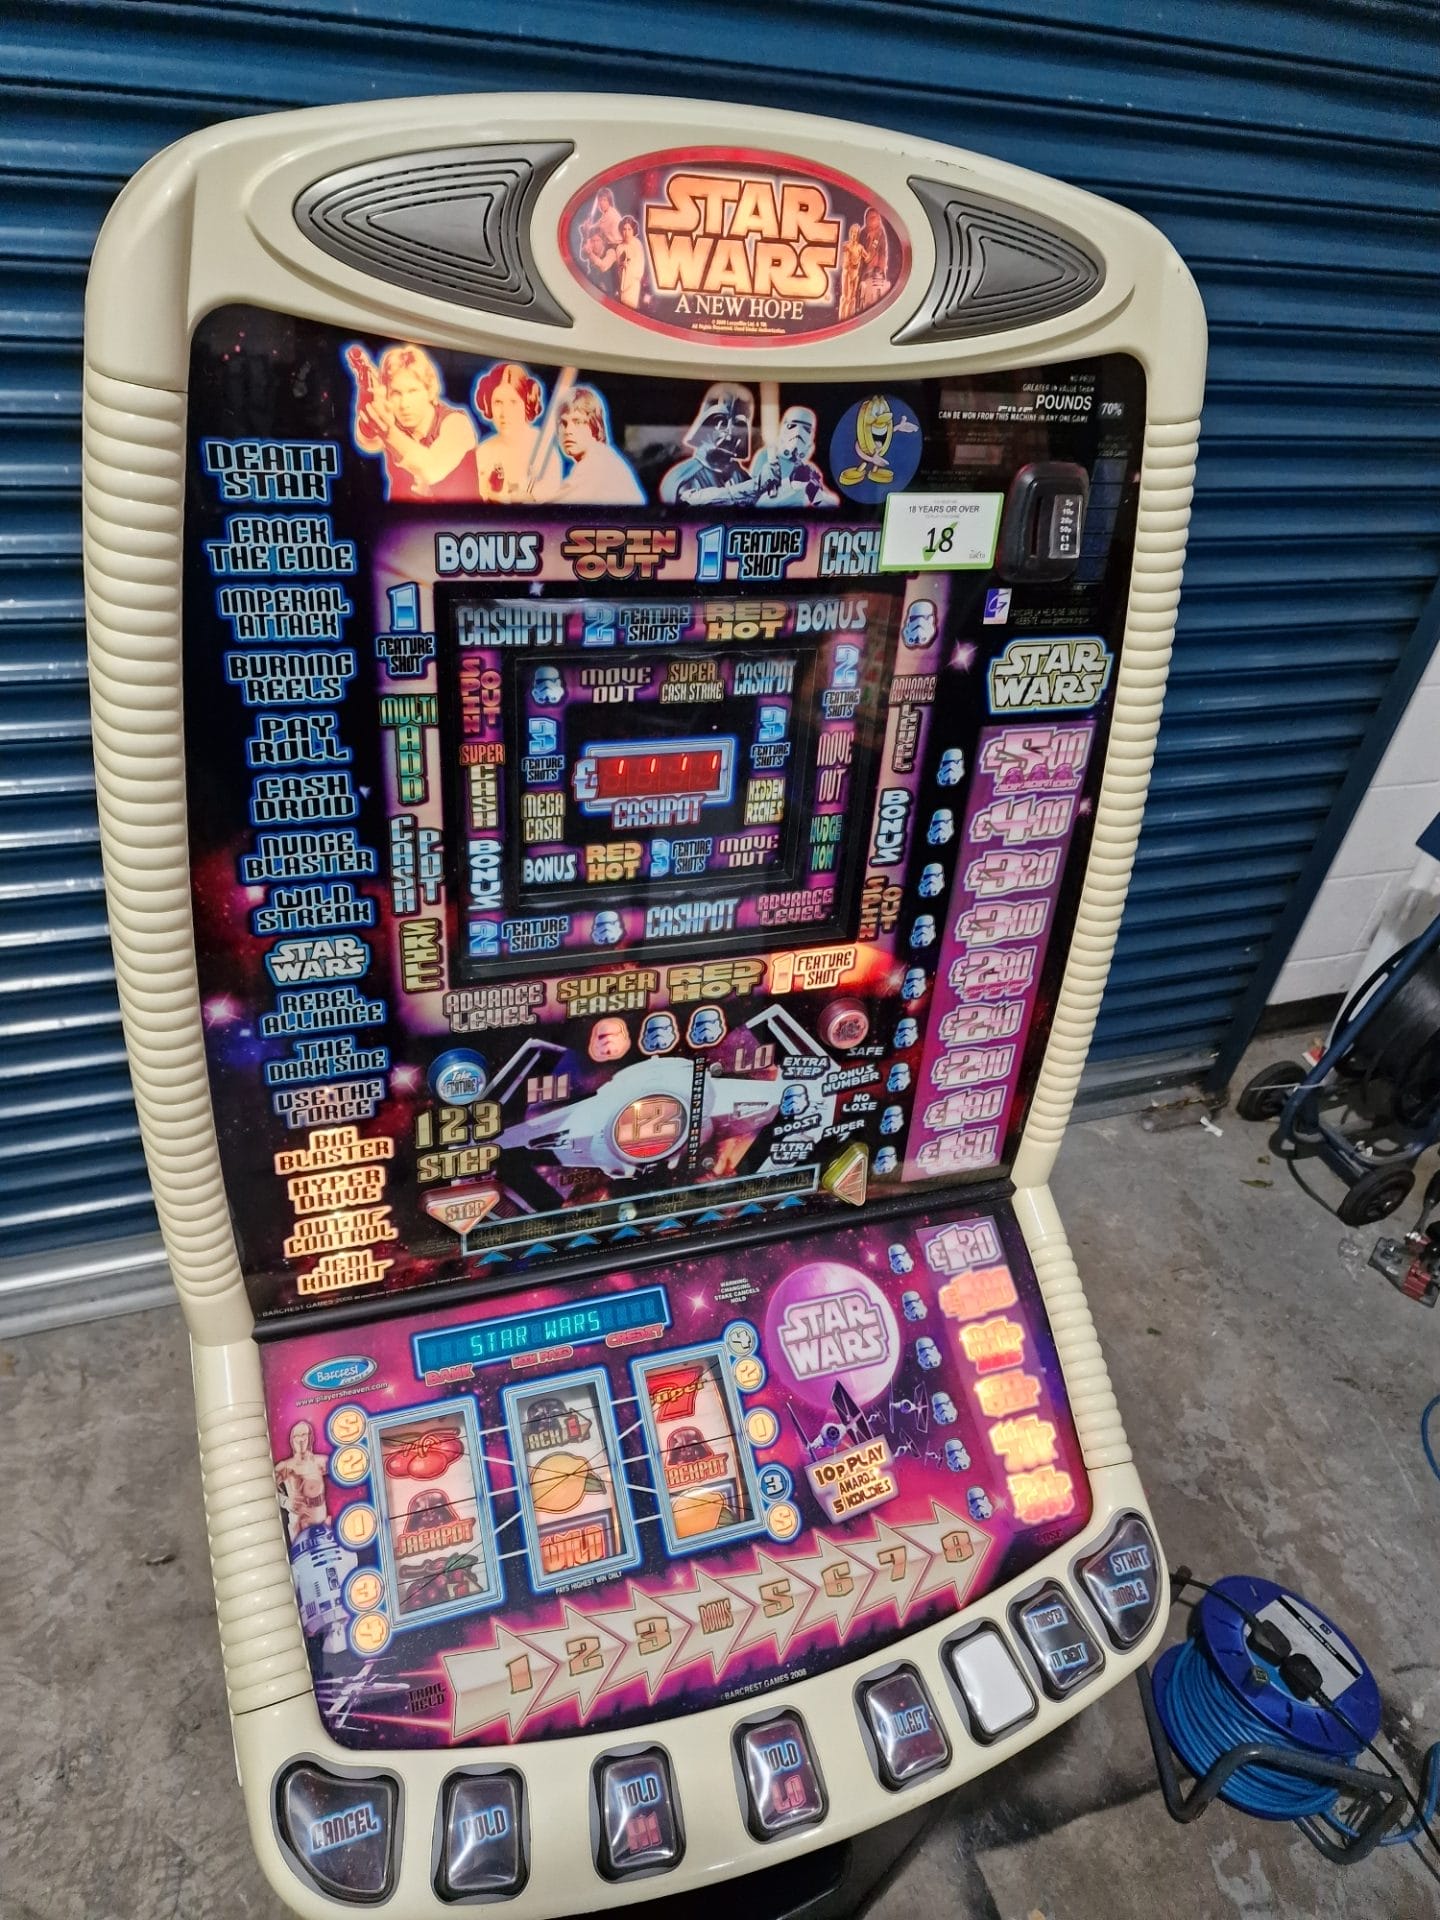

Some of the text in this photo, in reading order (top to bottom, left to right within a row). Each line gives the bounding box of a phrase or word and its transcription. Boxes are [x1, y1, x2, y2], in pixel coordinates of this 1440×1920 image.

[646, 174, 840, 242] STAR
[648, 233, 838, 299] WARS
[674, 294, 804, 320] A NEW HOPE
[939, 411, 951, 419] CAN
[953, 411, 960, 419] BE
[977, 412, 994, 420] FROM
[996, 412, 1008, 420] THIS
[1036, 395, 1092, 410] POUNDS
[1101, 402, 1122, 416] 70%
[206, 442, 337, 473] DEATH
[224, 471, 328, 500] STAR
[231, 518, 329, 545] CRACK
[564, 529, 676, 554] SPIN
[730, 529, 801, 554] FEATURE
[925, 528, 954, 552] 18
[207, 545, 353, 572] THE CODE
[436, 533, 539, 574] BONUS
[699, 526, 724, 580] 1
[743, 554, 785, 577] SHOT
[575, 554, 659, 579] OUT
[220, 587, 350, 615] IMPERIAL
[388, 583, 417, 631] 1
[703, 602, 786, 622] RED
[238, 613, 338, 639] ATTACK
[458, 607, 566, 646] CASHPOT
[585, 604, 614, 645] 2
[620, 606, 689, 625] FEATURE
[796, 601, 868, 632] BONUS
[629, 624, 678, 641] SHOTS
[707, 621, 784, 641] HOT
[377, 636, 434, 657] FEATURE
[995, 643, 1106, 676] STAR
[228, 653, 352, 681] BURNING
[390, 654, 424, 674] SHOT
[581, 667, 650, 685] MOVE
[669, 662, 716, 680] SUPER
[834, 644, 858, 686] 2
[247, 678, 343, 703] REELS
[734, 661, 797, 695] CASHPOT
[890, 675, 937, 702] ADVANCE
[994, 673, 1103, 708] WARS
[592, 685, 641, 703] OUT
[661, 684, 689, 703] CASH
[380, 695, 438, 726] MULTI
[759, 705, 787, 742] 3
[260, 715, 335, 741] PAY
[529, 718, 556, 755] 3
[250, 738, 349, 764] ROLL
[461, 744, 505, 765] SUPER
[523, 756, 564, 771] FEATURE
[257, 775, 347, 800] CASH
[819, 768, 847, 801] OUT
[255, 796, 355, 822] DROID
[523, 793, 565, 817] MEGA
[612, 797, 703, 829] CASHPOT
[525, 818, 563, 841] CASH
[261, 832, 354, 857] NUDGE
[586, 841, 643, 862] RED
[672, 839, 711, 858] FEATURE
[720, 835, 778, 853] MOVE
[245, 850, 374, 880] BLASTER
[524, 855, 577, 883] BONUS
[587, 861, 640, 882] HOT
[729, 850, 769, 868] OUT
[275, 885, 351, 909] WILD
[257, 902, 370, 932] STREAK
[503, 917, 568, 938] FEATURE
[646, 898, 739, 939] CASHPOT
[760, 906, 829, 925] LEVEL
[271, 938, 365, 963] STAR
[470, 921, 498, 956] 2
[511, 935, 559, 951] SHOTS
[271, 956, 365, 983] WARS
[668, 959, 765, 986] RED
[796, 950, 853, 971] FEATURE
[558, 970, 658, 1002] SUPER
[771, 954, 794, 994] 1
[806, 969, 839, 986] SHOT
[281, 988, 362, 1013] REBEL
[444, 982, 545, 1015] ADVANCE
[670, 977, 761, 1002] HOT
[568, 991, 646, 1018] CASH
[263, 1003, 382, 1035] ALLIANCE
[451, 1007, 537, 1032] LEVEL
[299, 1039, 351, 1060] THE
[784, 1057, 827, 1067] EXTRA
[848, 1047, 883, 1056] SAFE
[269, 1050, 385, 1083] DARK SIDE
[784, 1067, 821, 1076] STEP
[829, 1065, 874, 1082] BONUS
[527, 1074, 570, 1103] HI
[823, 1072, 879, 1092] NUMBER
[277, 1081, 381, 1111] USE THE
[843, 1102, 877, 1112] LOSE
[854, 1093, 870, 1102] NO
[291, 1100, 370, 1127] FORCE
[416, 1102, 500, 1148] 1 2 3
[774, 1116, 819, 1136] BOOST
[315, 1130, 353, 1149] BIG
[823, 1120, 864, 1137] SUPER
[279, 1141, 390, 1171] BLASTER
[771, 1143, 813, 1152] EXTRA
[772, 1152, 808, 1161] LIFE
[418, 1144, 499, 1183] STEP
[293, 1170, 381, 1196] HYPER
[300, 1184, 377, 1210] DRIVE
[446, 1200, 485, 1221] STEP
[299, 1210, 383, 1238] OUT OF
[288, 1223, 394, 1254] CONTROL
[316, 1252, 369, 1274] JEDI
[301, 1265, 382, 1292] KNIGHT
[783, 1296, 877, 1340] STAR
[471, 1311, 600, 1356] STAR WARS
[783, 1328, 882, 1375] WARS
[316, 1365, 359, 1384] Barcrest
[295, 1383, 388, 1407] www.playersheaven.com
[846, 1445, 884, 1472] PLAY
[833, 1500, 844, 1513] 5
[941, 1531, 973, 1562] 8
[878, 1546, 908, 1581] 7
[1112, 1547, 1149, 1574] START
[556, 1572, 622, 1594] PAYS HIGHEST WIN ONLY
[820, 1562, 852, 1598] 6
[635, 1616, 670, 1654] 3
[566, 1638, 602, 1676] 2
[505, 1654, 532, 1694] 1
[312, 1807, 378, 1849] CANCEL
